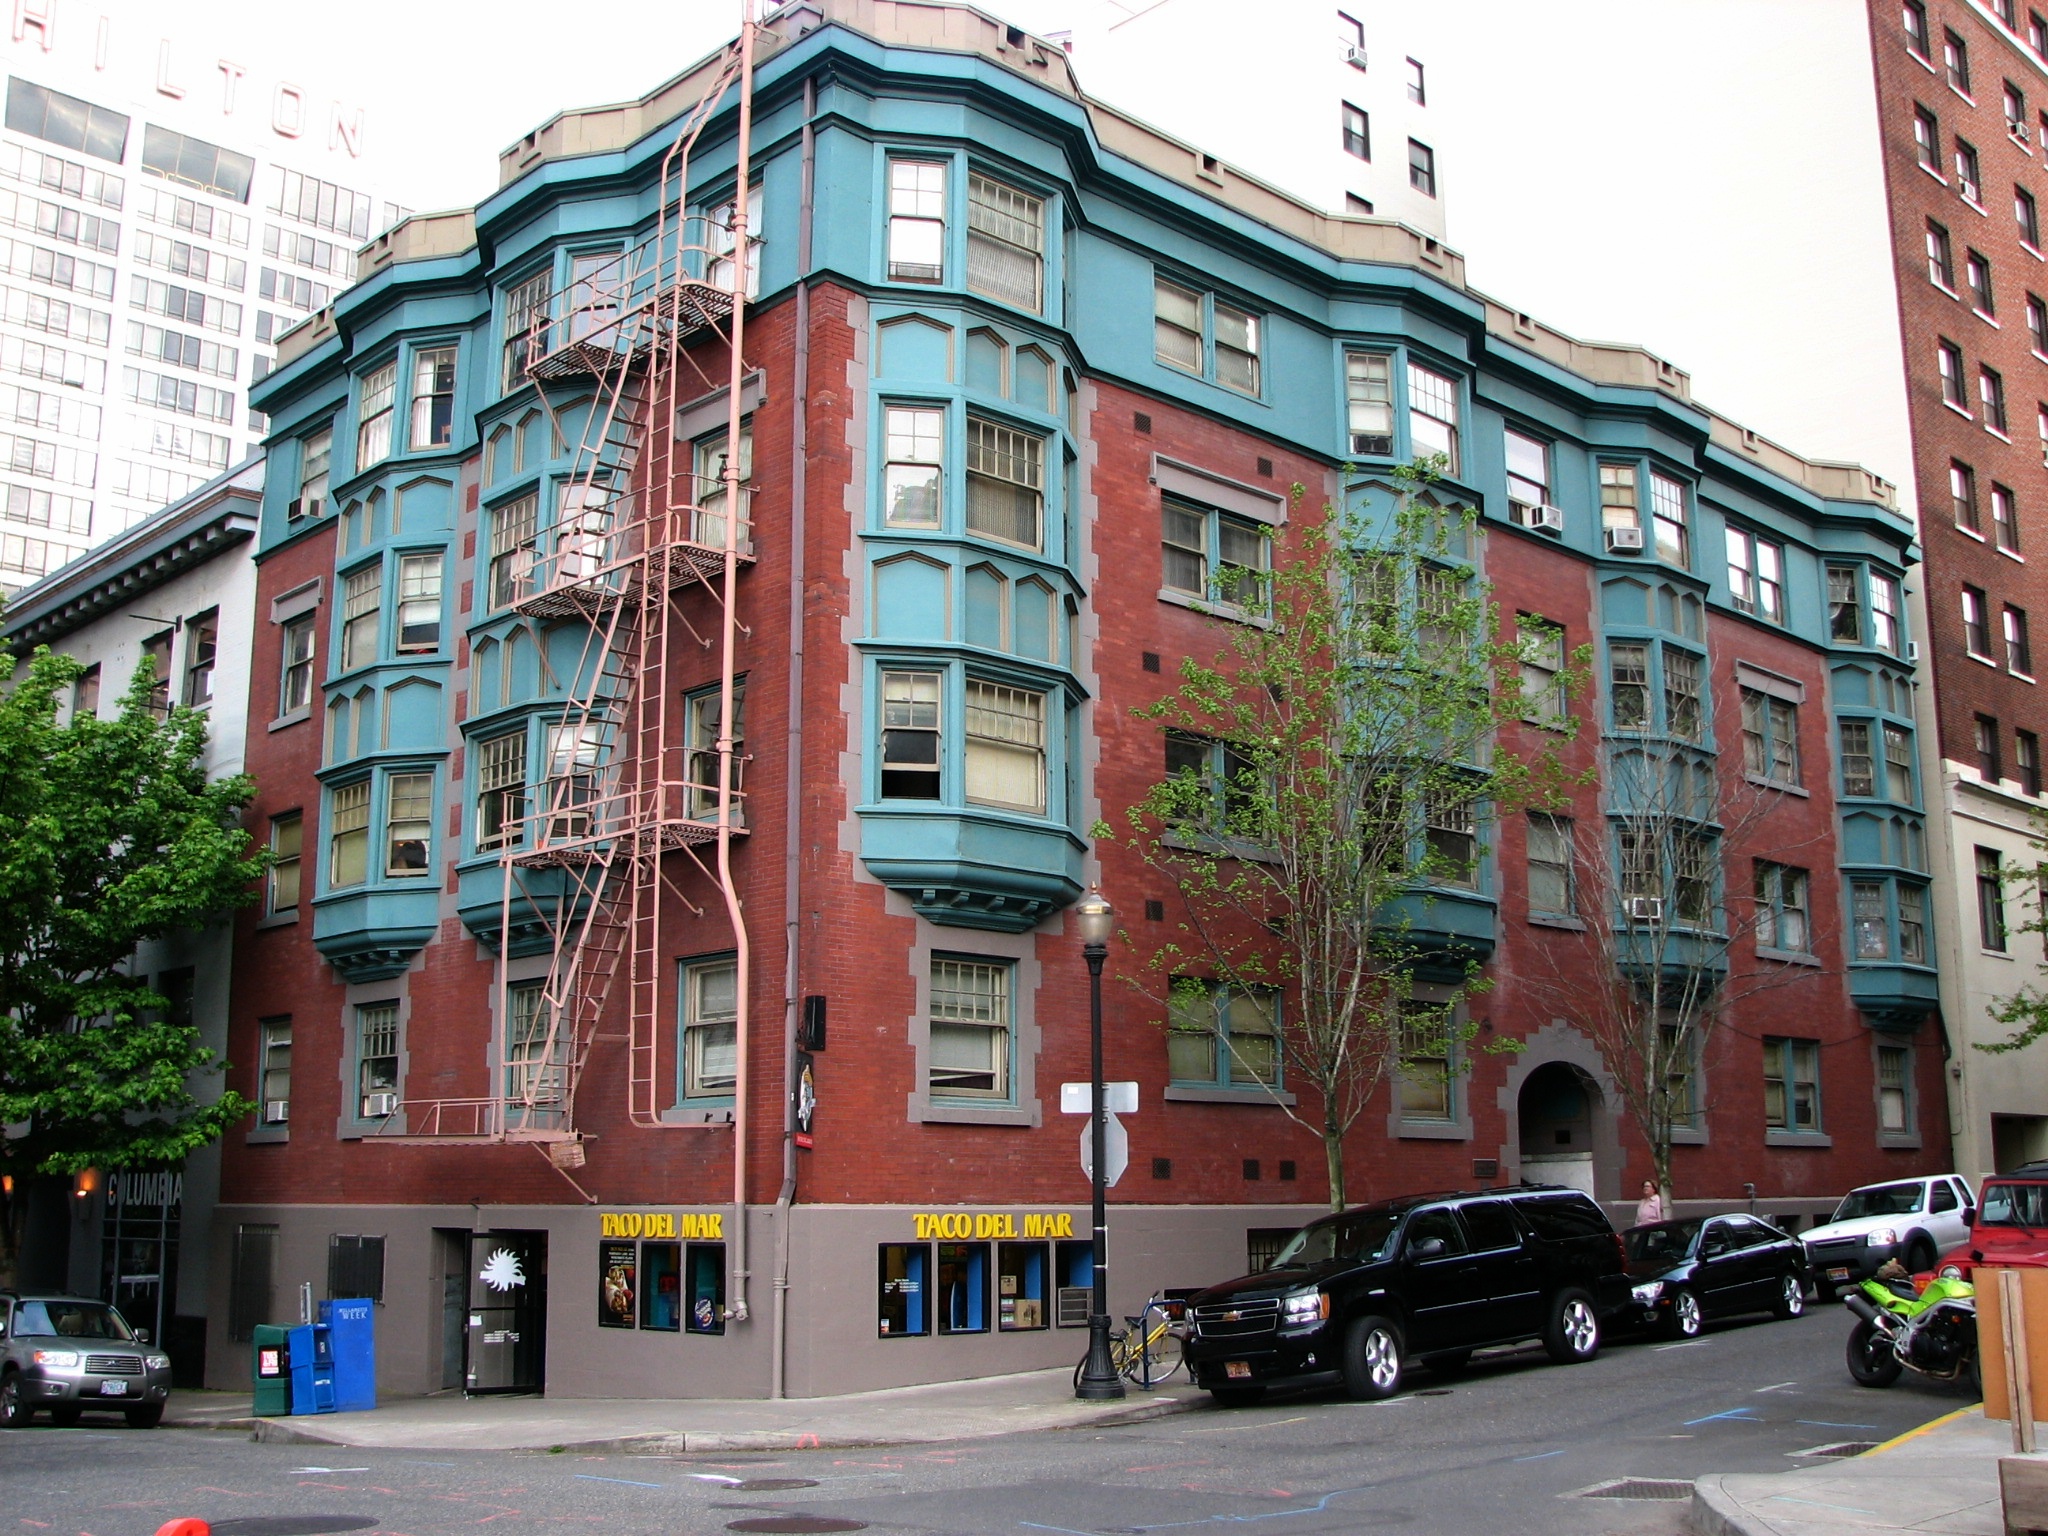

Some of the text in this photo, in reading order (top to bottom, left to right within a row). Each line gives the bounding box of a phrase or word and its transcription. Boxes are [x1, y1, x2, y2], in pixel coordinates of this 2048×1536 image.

[13, 0, 364, 157] HILTON
[108, 1173, 183, 1206] COLUMBIA
[600, 1213, 724, 1239] TACO DEL MAR
[912, 1213, 1074, 1240] TACO DEL MAR
[342, 1312, 367, 1320] WEEK
